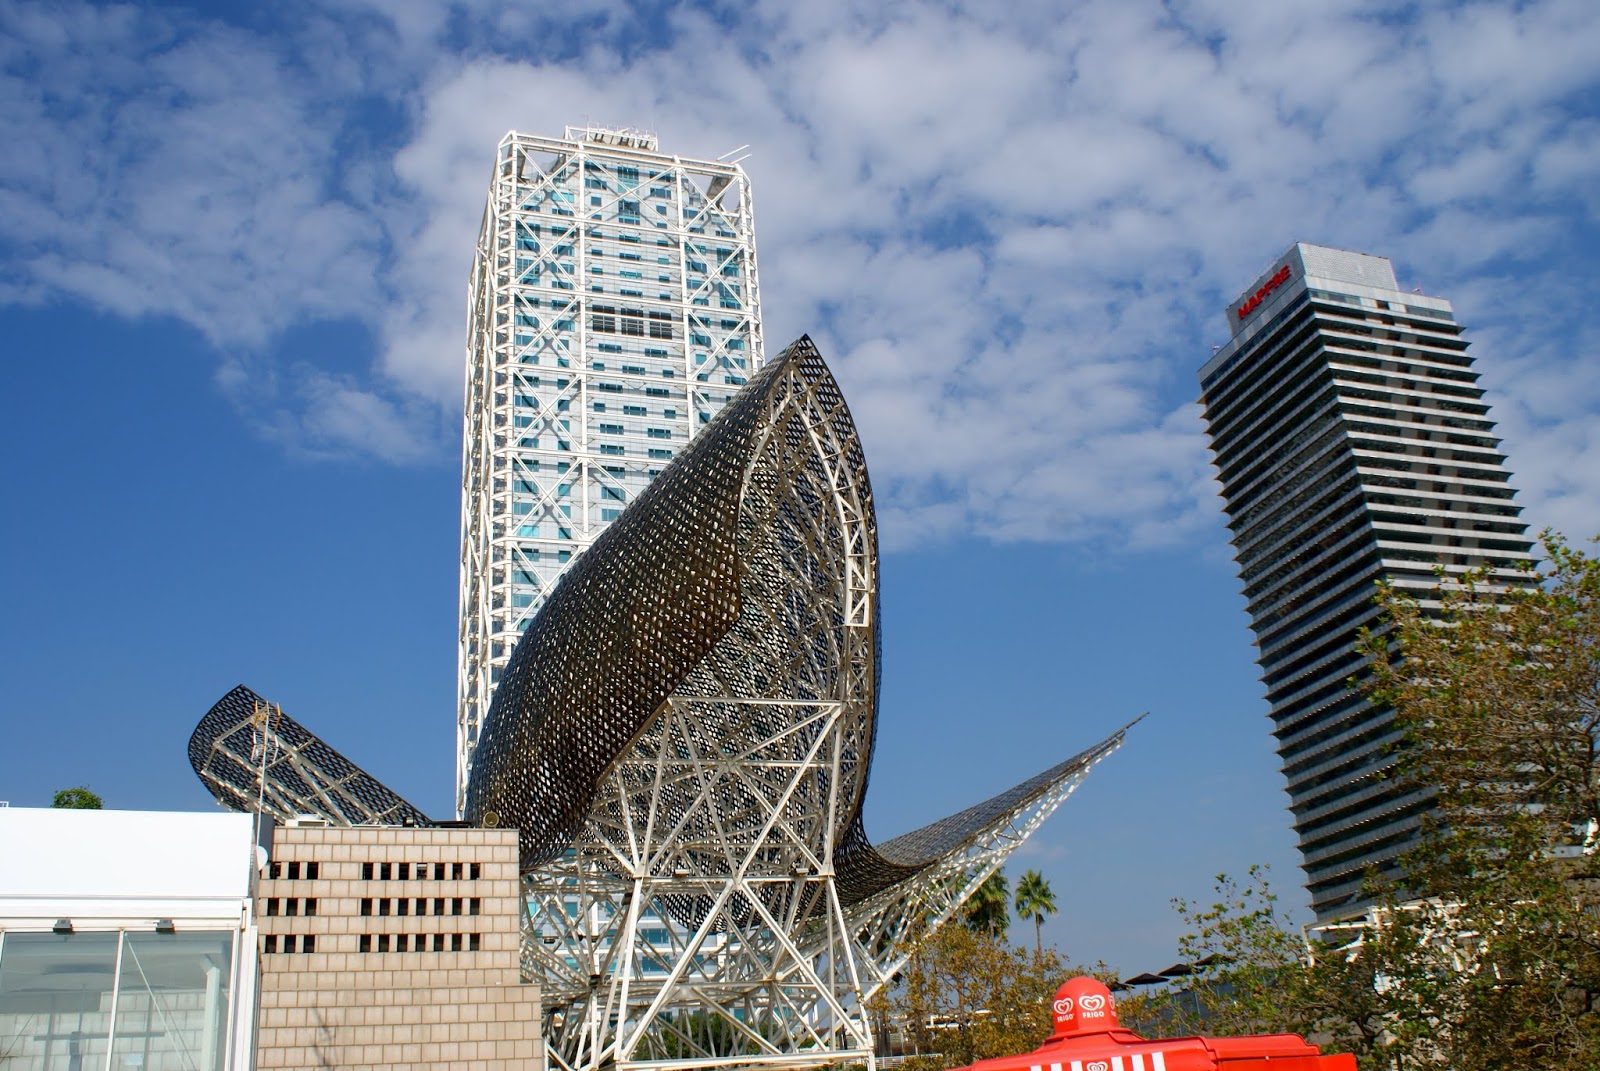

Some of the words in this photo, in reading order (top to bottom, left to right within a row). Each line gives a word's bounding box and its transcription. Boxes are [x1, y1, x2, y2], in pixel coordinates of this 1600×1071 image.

[1238, 264, 1291, 320] MAPFRE
[1057, 1013, 1074, 1023] FRIGO
[1082, 1010, 1105, 1019] FRIGO
